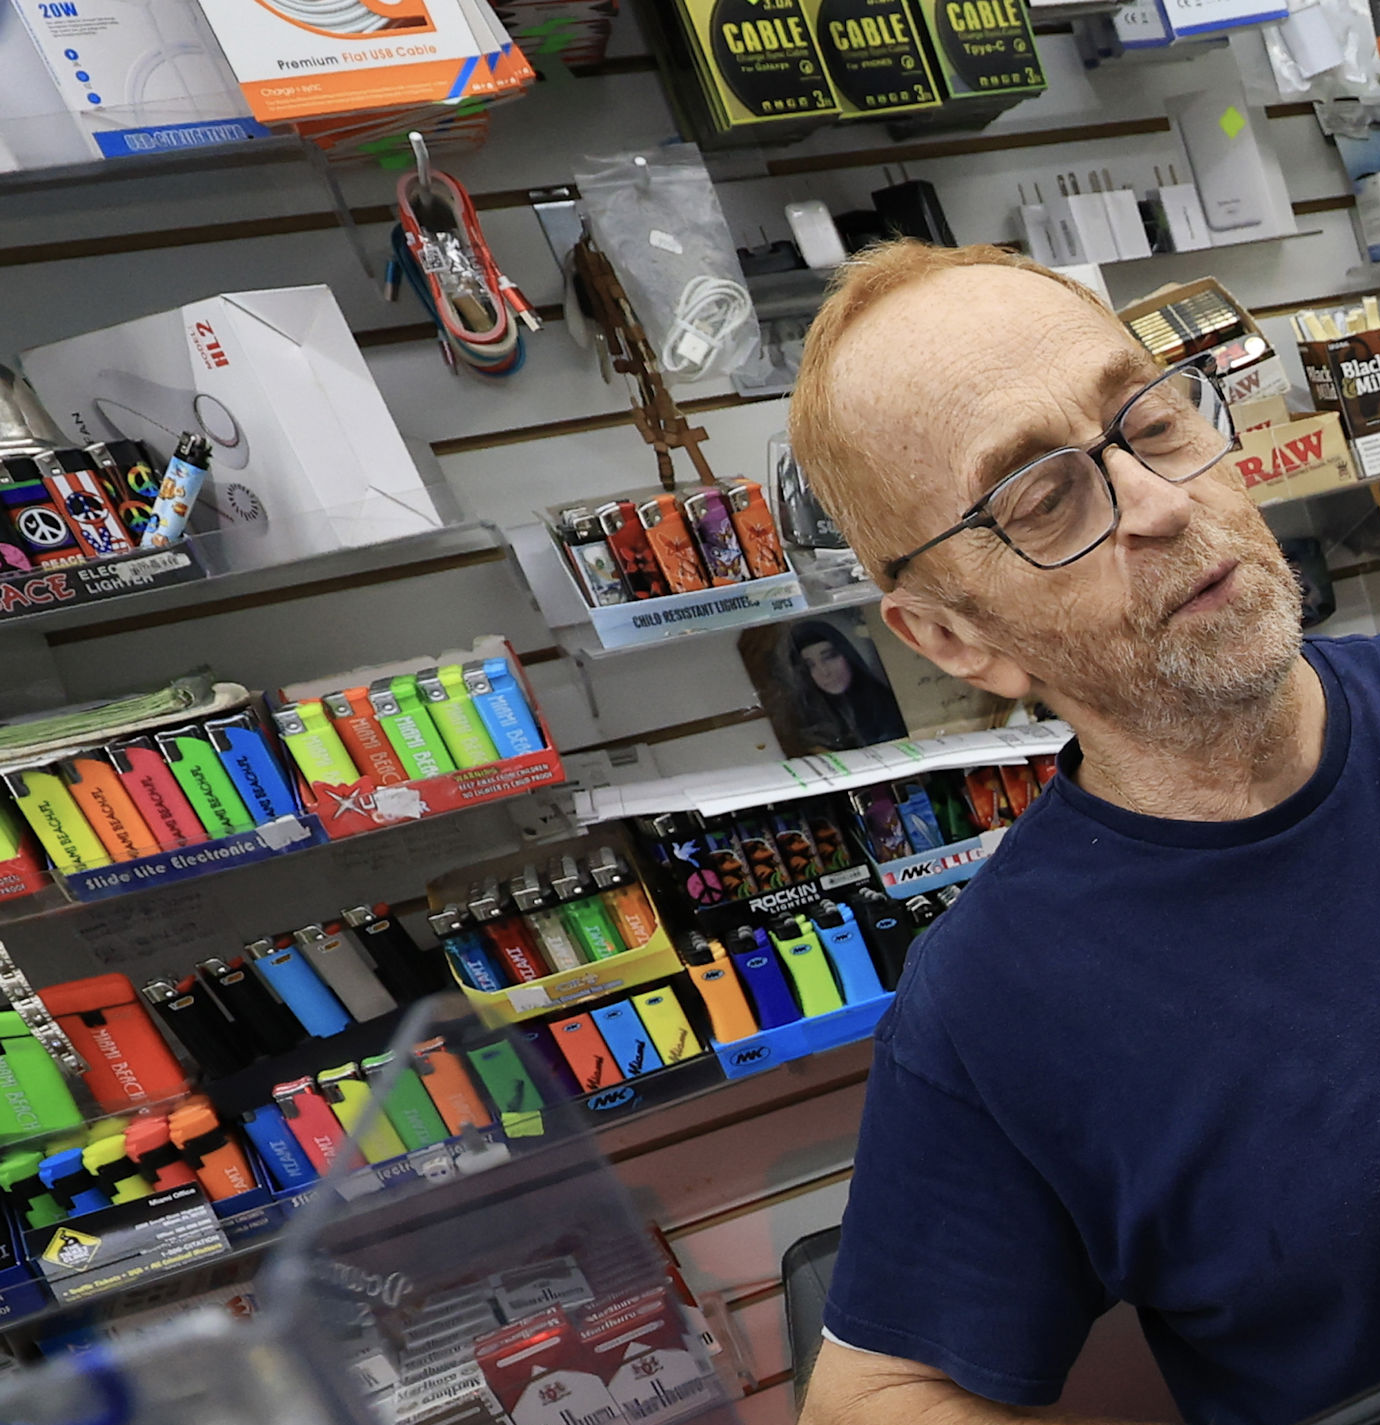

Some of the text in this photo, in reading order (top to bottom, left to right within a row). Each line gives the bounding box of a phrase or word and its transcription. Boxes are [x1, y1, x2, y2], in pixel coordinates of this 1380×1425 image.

[722, 16, 808, 54] CABLE
[829, 13, 910, 50] CABLE
[277, 43, 438, 71] Premium Flat USB Cable
[1235, 429, 1323, 488] RAW
[633, 613, 662, 629] CHILD
[663, 605, 717, 623] RESISTANT
[395, 716, 425, 750] MIAMI
[86, 870, 131, 890] Slide
[171, 841, 254, 870] Electronic
[902, 862, 932, 882] MK
[749, 882, 817, 914] ROCKIN
[770, 895, 821, 914] LIGHTERS
